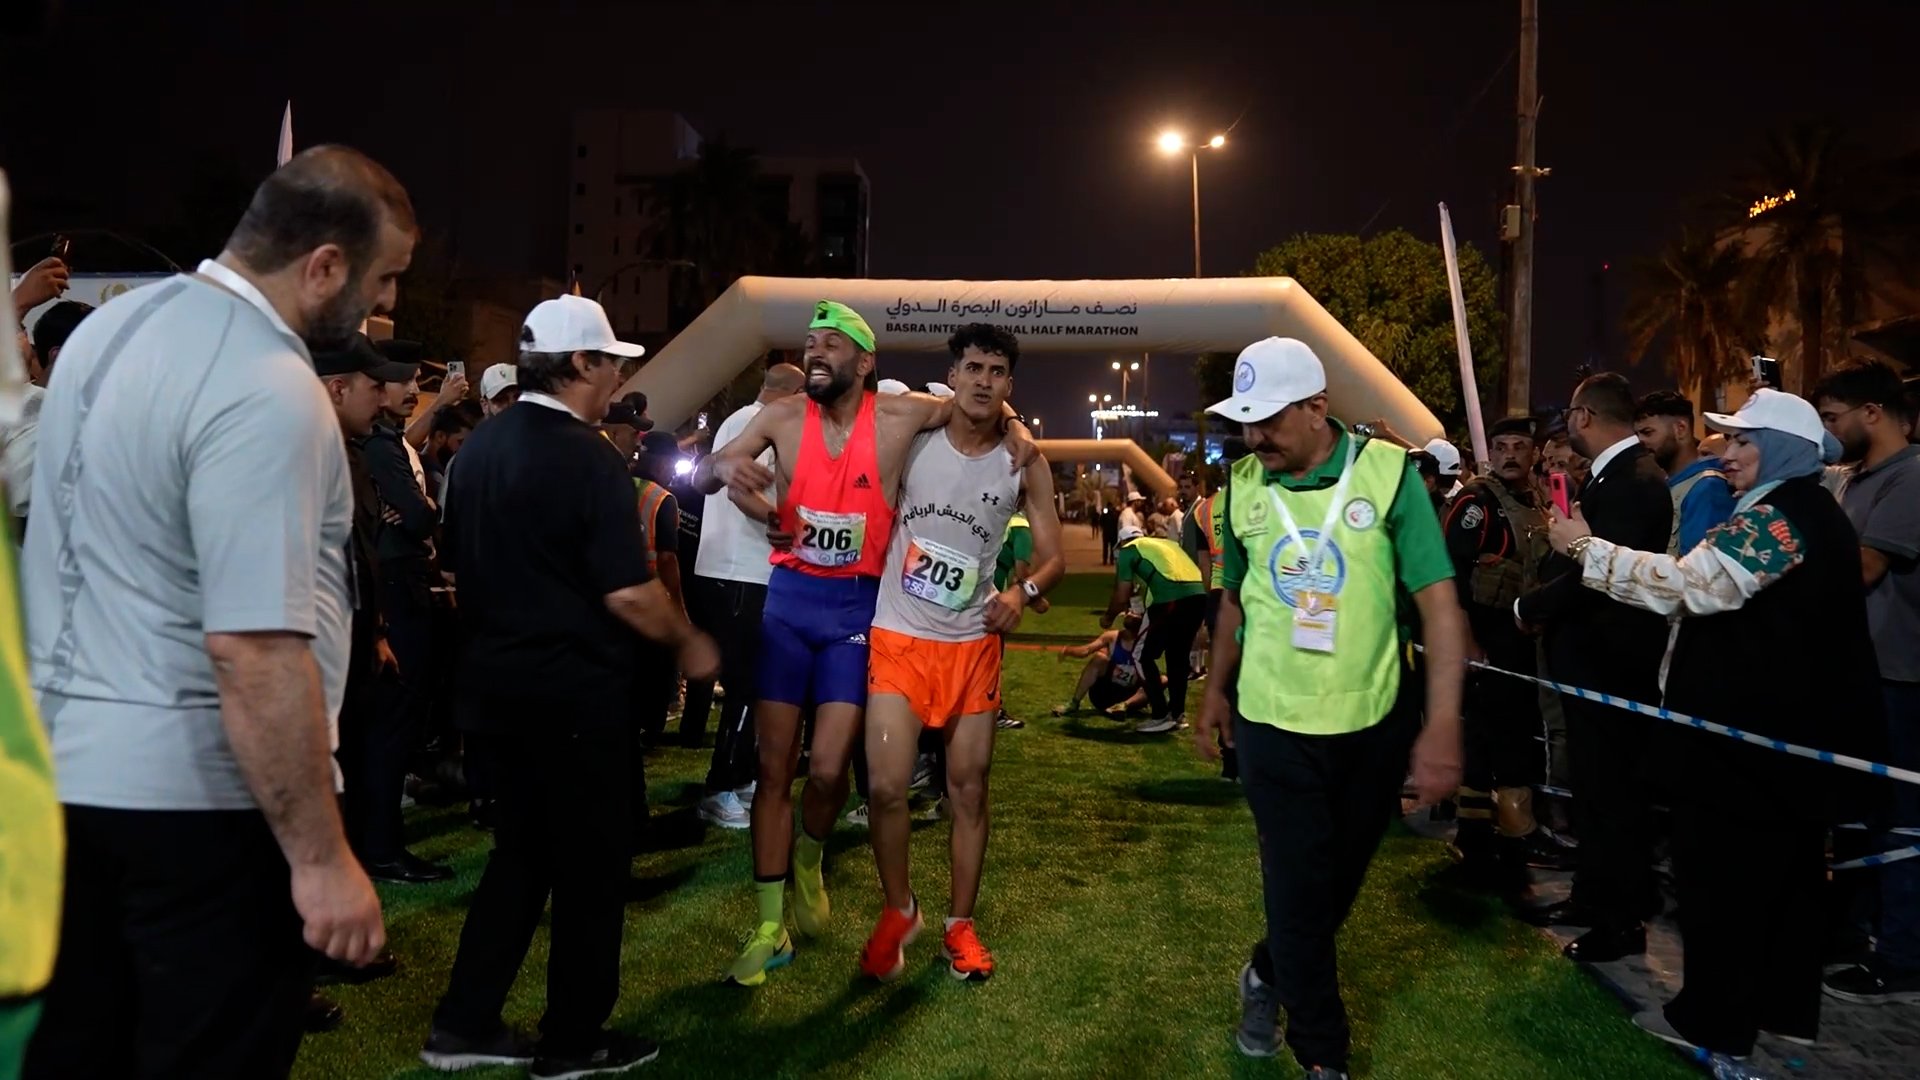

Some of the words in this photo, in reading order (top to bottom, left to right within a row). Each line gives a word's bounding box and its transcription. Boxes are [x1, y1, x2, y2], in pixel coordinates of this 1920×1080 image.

[886, 297, 947, 320] الدولي
[950, 298, 1001, 318] البصرة
[1004, 298, 1081, 318] ماراثون
[1085, 300, 1138, 315] نصف
[886, 322, 927, 334] BASRA
[929, 323, 1029, 335] INTEONAL
[1031, 325, 1064, 335] HALF
[1065, 326, 1139, 336] MARATHON
[936, 503, 976, 526] الجيش
[802, 524, 852, 551] 206
[971, 524, 991, 544] نادي
[845, 551, 857, 563] 47
[912, 554, 965, 592] 203
